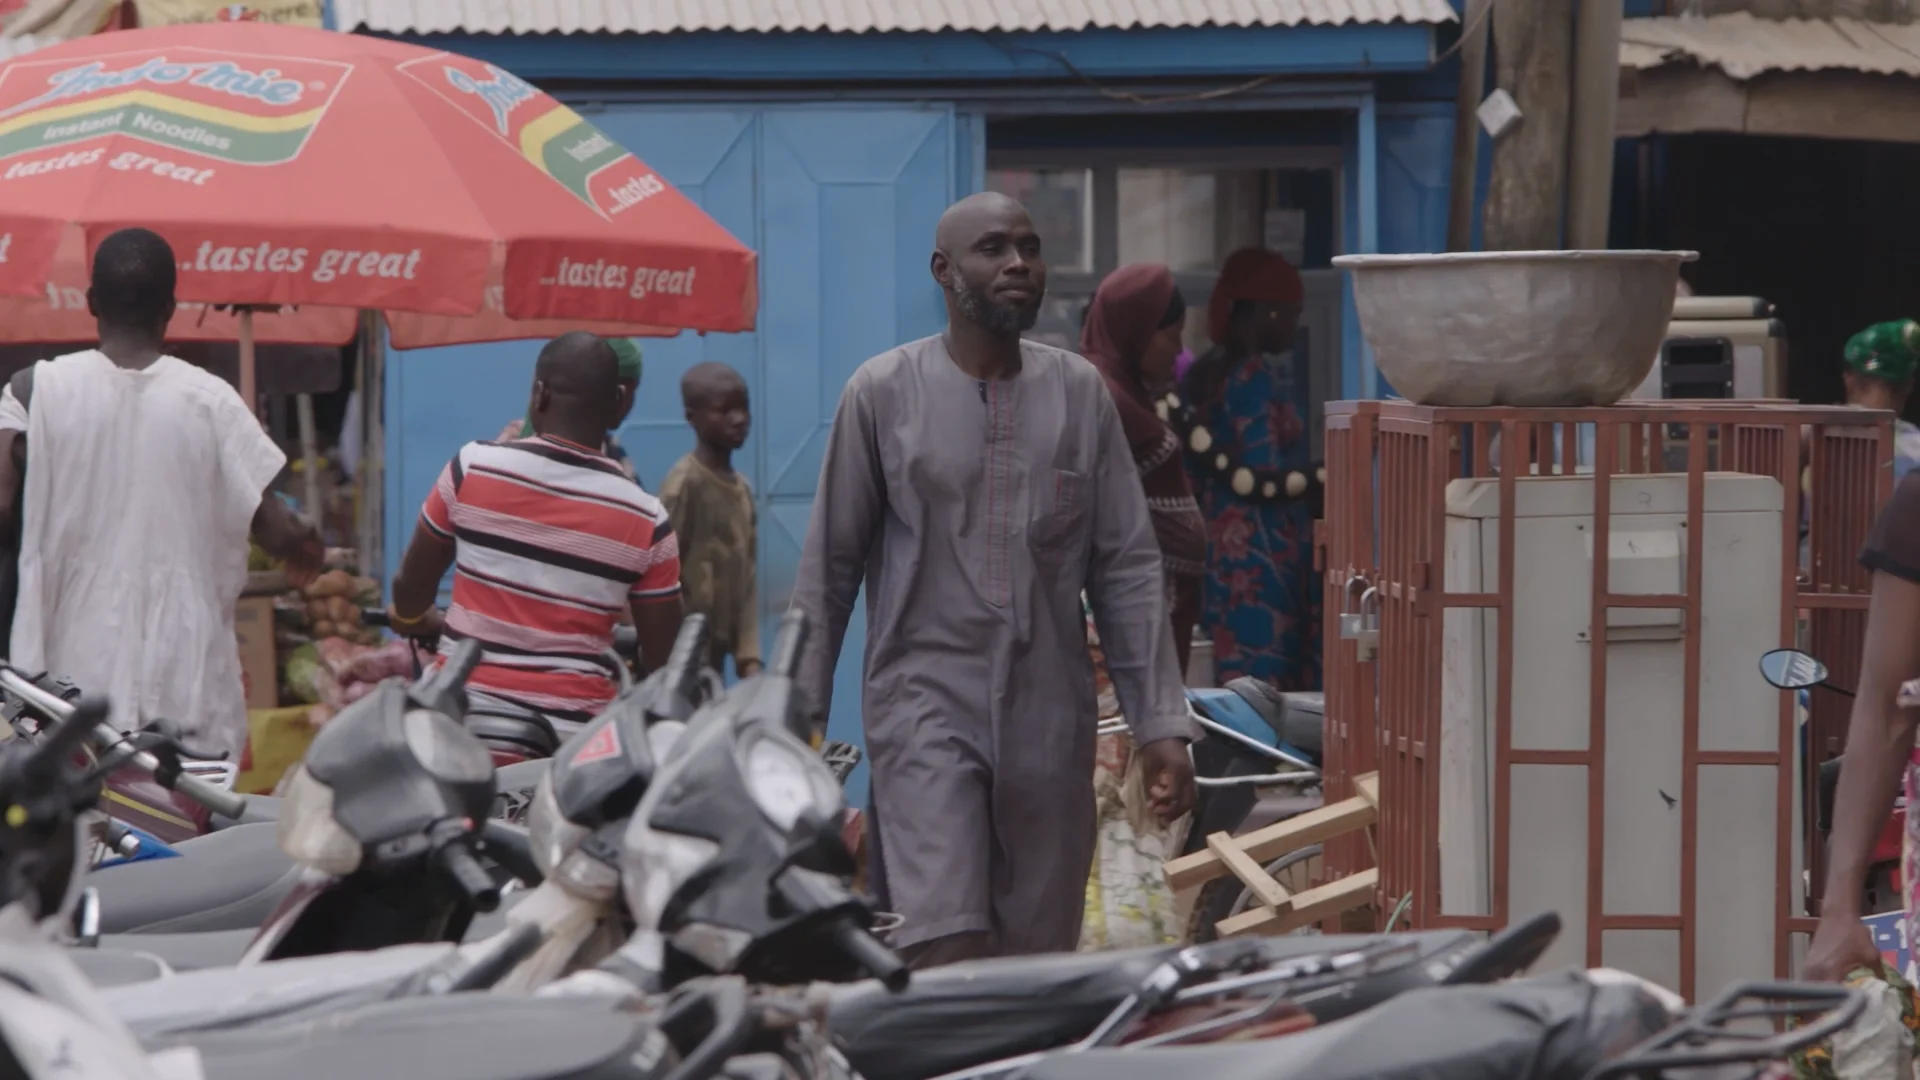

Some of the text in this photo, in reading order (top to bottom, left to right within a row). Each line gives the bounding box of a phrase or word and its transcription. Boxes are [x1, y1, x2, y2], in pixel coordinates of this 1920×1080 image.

[132, 111, 232, 151] Noodles
[108, 151, 215, 185] great
[312, 248, 421, 283] great
[629, 265, 696, 299] great
